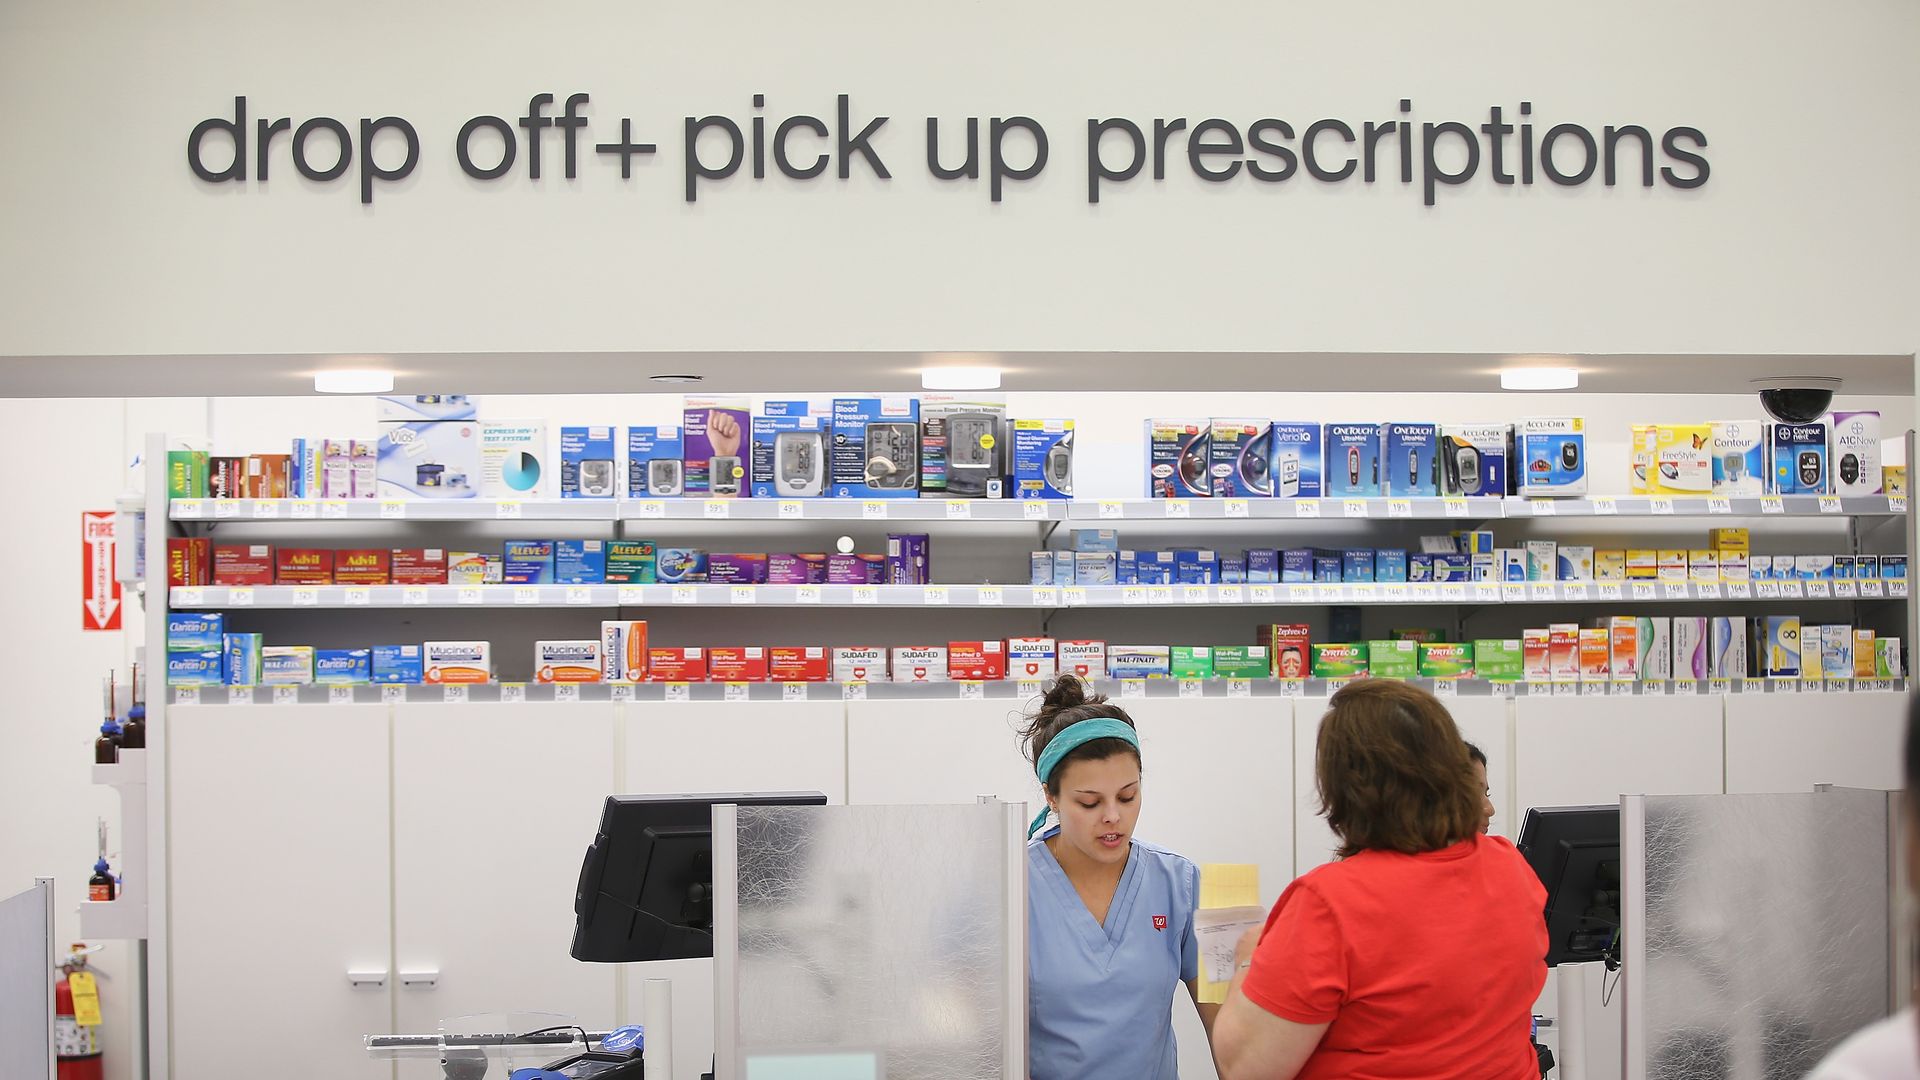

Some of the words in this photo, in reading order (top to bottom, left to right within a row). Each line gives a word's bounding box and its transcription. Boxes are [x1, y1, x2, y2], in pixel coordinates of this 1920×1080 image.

[187, 95, 420, 204] drop
[685, 94, 892, 203] pick
[926, 116, 1049, 203] up
[1087, 98, 1711, 206] prescriptions
[1792, 427, 1820, 436] Contour
[1714, 438, 1752, 448] Contour
[1662, 452, 1696, 460] FreeStyle
[510, 546, 550, 556] ALEVE-D
[610, 546, 652, 555] ALEVE-D
[290, 554, 320, 564] Advil
[346, 555, 378, 565] Advil
[172, 550, 183, 580] Advil
[1278, 628, 1308, 636] Zephrex-D
[1320, 648, 1358, 656] ZYRTEC-D
[1426, 648, 1464, 656] ZYRTEC-D
